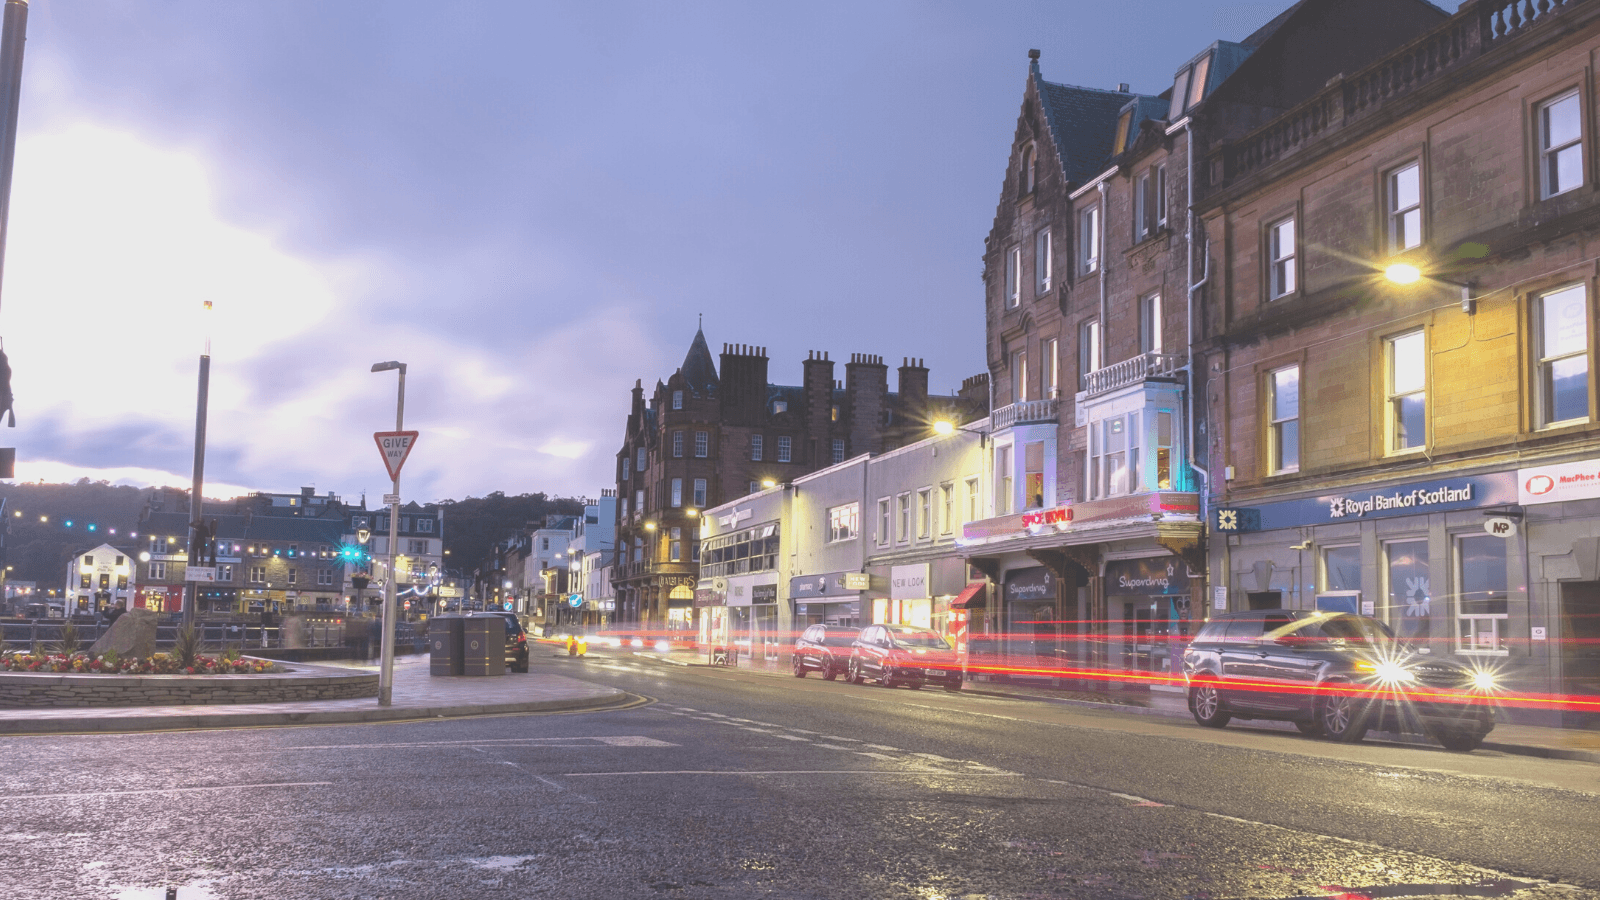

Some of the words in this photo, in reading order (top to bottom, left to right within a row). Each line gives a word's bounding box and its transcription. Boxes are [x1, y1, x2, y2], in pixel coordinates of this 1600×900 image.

[384, 438, 408, 448] GIVE
[1559, 473, 1595, 484] MacPhee
[1345, 495, 1374, 517] Royal
[1375, 492, 1405, 510] Bank
[1403, 490, 1418, 507] of
[1418, 483, 1471, 506] Scotland
[892, 578, 906, 588] NEW
[907, 577, 925, 587] LOOK
[1119, 575, 1169, 589] Superdrug
[1010, 583, 1046, 595] Superdrug
